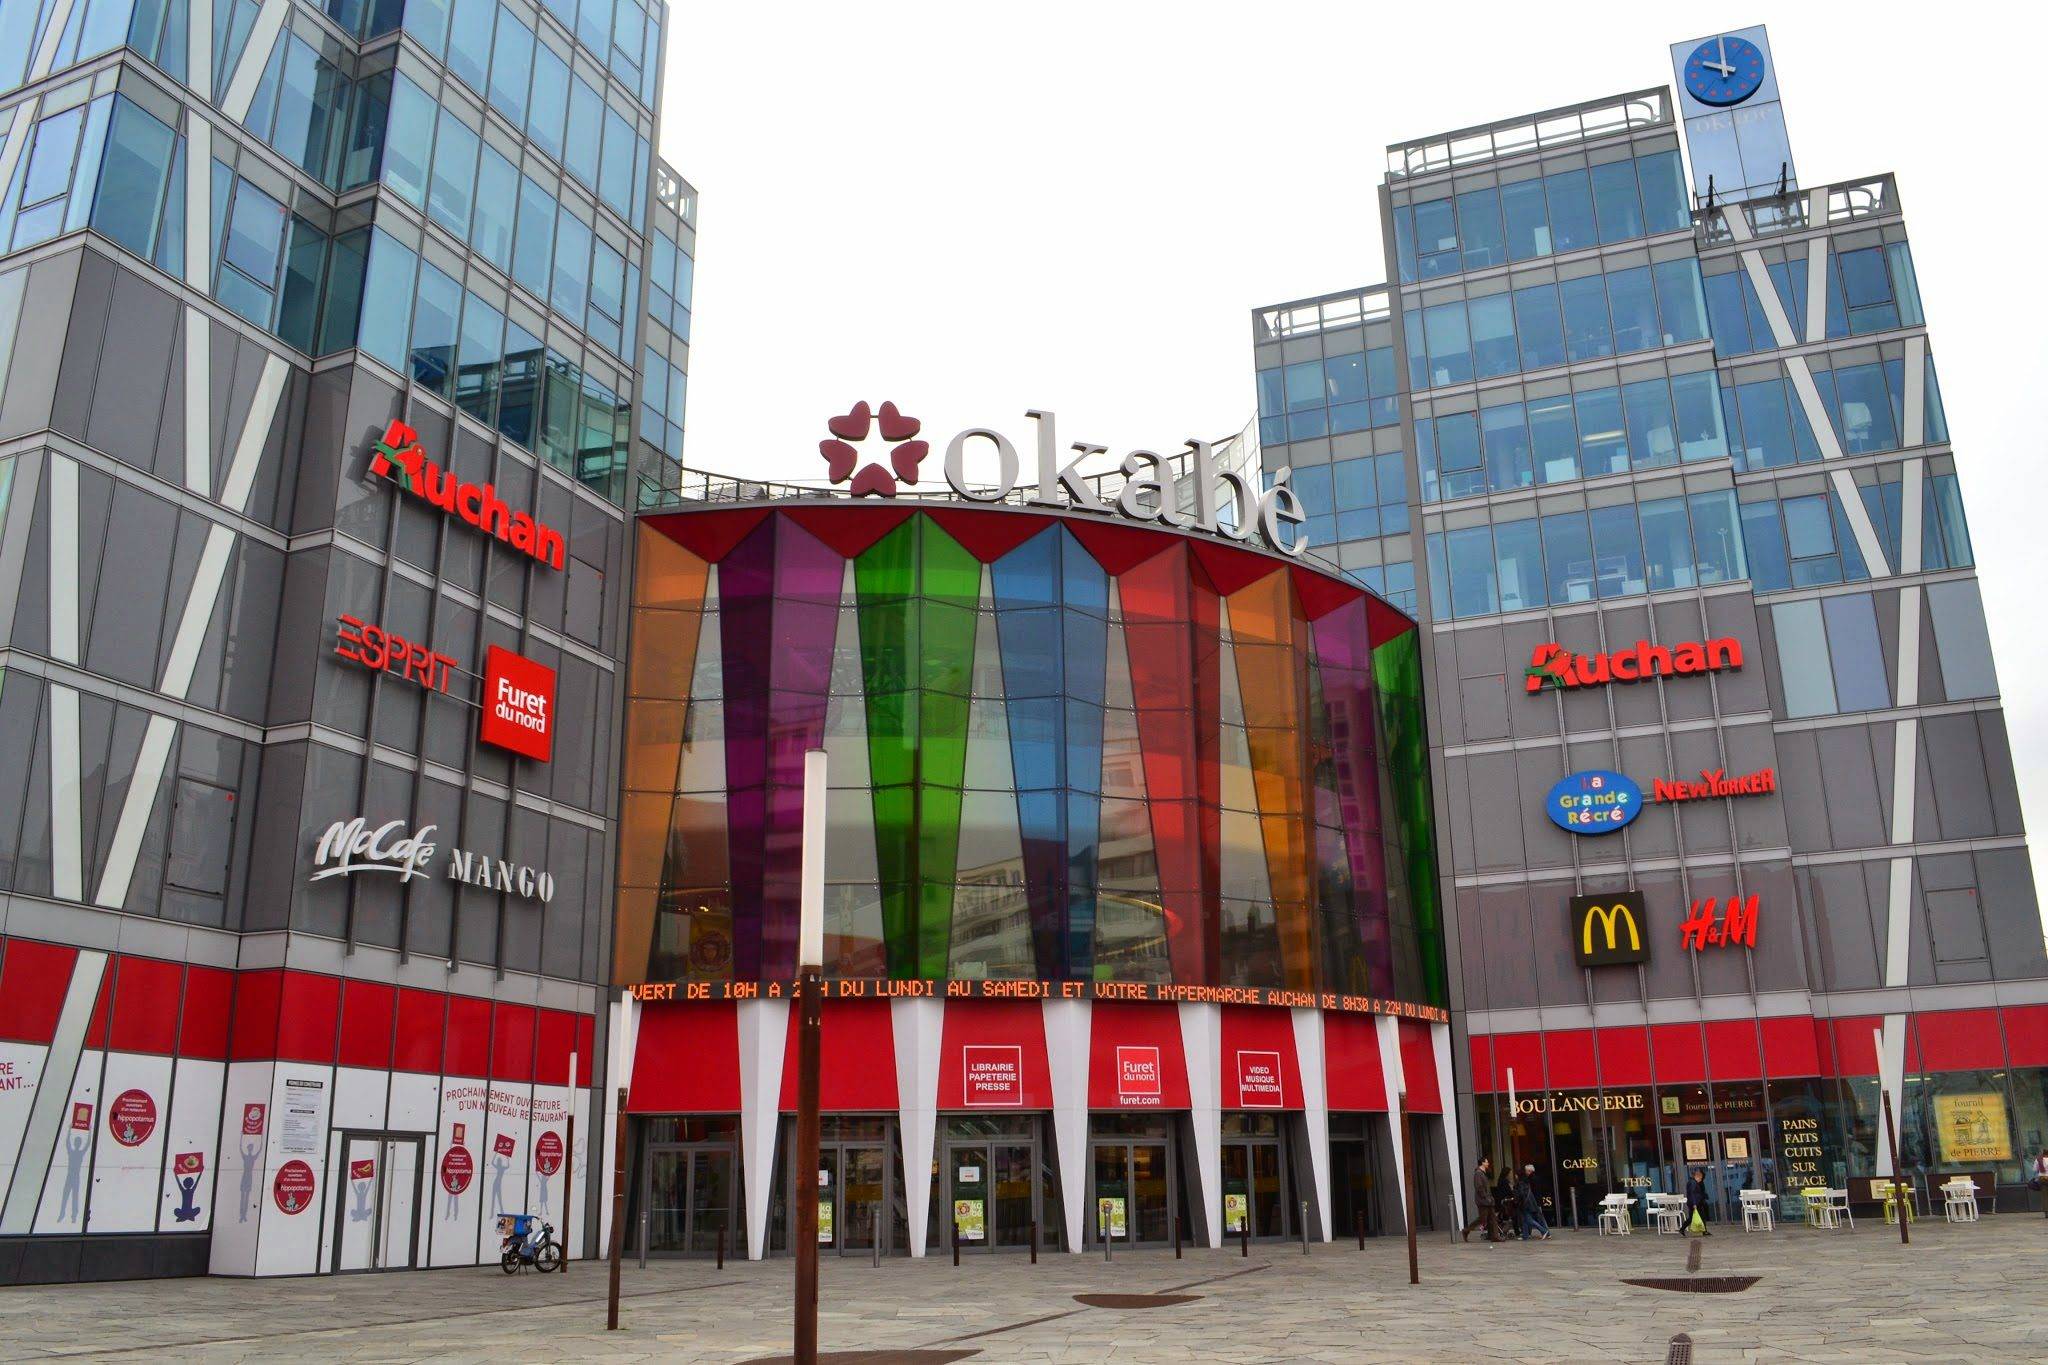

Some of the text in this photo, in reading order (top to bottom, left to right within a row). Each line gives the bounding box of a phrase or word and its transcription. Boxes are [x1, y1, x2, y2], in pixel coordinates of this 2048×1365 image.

[943, 408, 1308, 557] okabé
[369, 418, 566, 572] Auchan
[335, 613, 457, 694] ESPRIT
[1525, 636, 1744, 693] Auchan
[497, 677, 547, 718] Furet
[496, 703, 545, 734] du nord
[1560, 791, 1628, 808] Grande
[1567, 806, 1625, 824] Récré
[448, 848, 554, 903] MANGO
[1680, 895, 1760, 952] H&M
[629, 984, 676, 1000] VERT
[687, 983, 711, 999] DE
[724, 982, 757, 998] 10H
[769, 982, 781, 998] A
[793, 981, 829, 998] 2H
[840, 981, 864, 997] DU
[876, 981, 934, 997] LUNDI
[947, 982, 971, 997] AU
[983, 981, 1050, 997] SAMEDI
[1062, 982, 1085, 998] ET
[1095, 983, 1148, 999] VOTRE
[1158, 985, 1260, 1004] HYPERMARCHE
[1268, 991, 1316, 1007] AUCHAN
[1322, 994, 1337, 1009] DE
[1373, 999, 1381, 1013] A
[1385, 1000, 1401, 1015] 22H
[1405, 1003, 1415, 1016] DU
[1419, 1005, 1439, 1021] LUNDI
[971, 1063, 1014, 1071] LIBRAIRIE
[1123, 1061, 1154, 1073] Furet
[1249, 1066, 1269, 1074] VIDEO
[969, 1073, 1017, 1081] PAPETERIE
[1123, 1073, 1155, 1081] du nord
[1245, 1075, 1275, 1083] MUSIQUE
[975, 1082, 1011, 1091] PRESSE
[1240, 1084, 1280, 1092] MULTIMEDIA
[446, 1087, 514, 1105] PROCHAINEMENT
[1120, 1095, 1160, 1105] furet.com
[1783, 1119, 1817, 1129] PAINS
[1784, 1133, 1818, 1143] FAITS
[1785, 1147, 1822, 1157] CUITS
[1950, 1147, 2001, 1157] de PIERRE
[1562, 1157, 1598, 1169] CAFÉS
[1793, 1162, 1817, 1172] SUR
[1621, 1176, 1652, 1188] THÉS
[1787, 1176, 1827, 1187] PLACE
